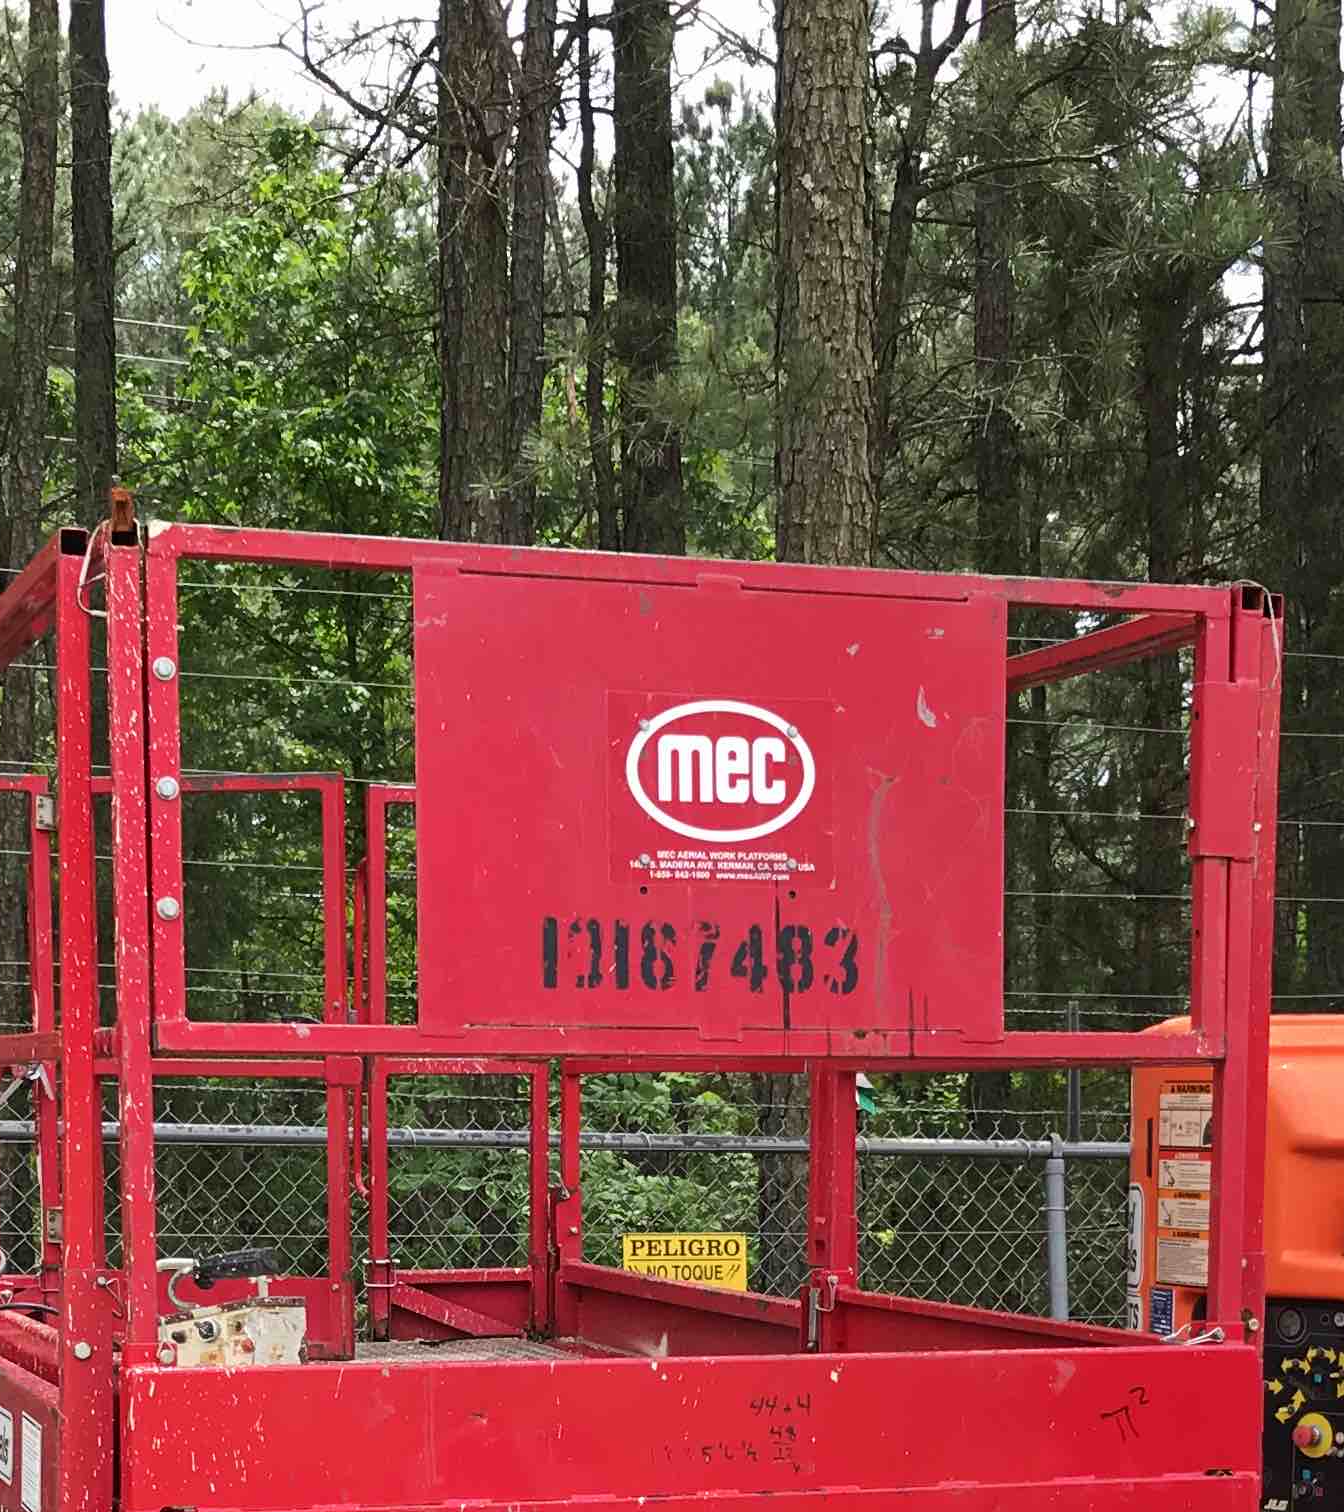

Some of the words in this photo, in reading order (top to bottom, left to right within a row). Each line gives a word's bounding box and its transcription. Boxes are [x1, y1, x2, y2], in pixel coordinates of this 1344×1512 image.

[677, 851, 707, 860] AERIAL
[709, 852, 736, 860] WORK
[737, 852, 788, 861] PLATFORMS
[798, 863, 816, 872] USA
[630, 1238, 740, 1257] PELIGRO
[646, 1264, 668, 1280] NO
[673, 1264, 724, 1281] TOQUE
